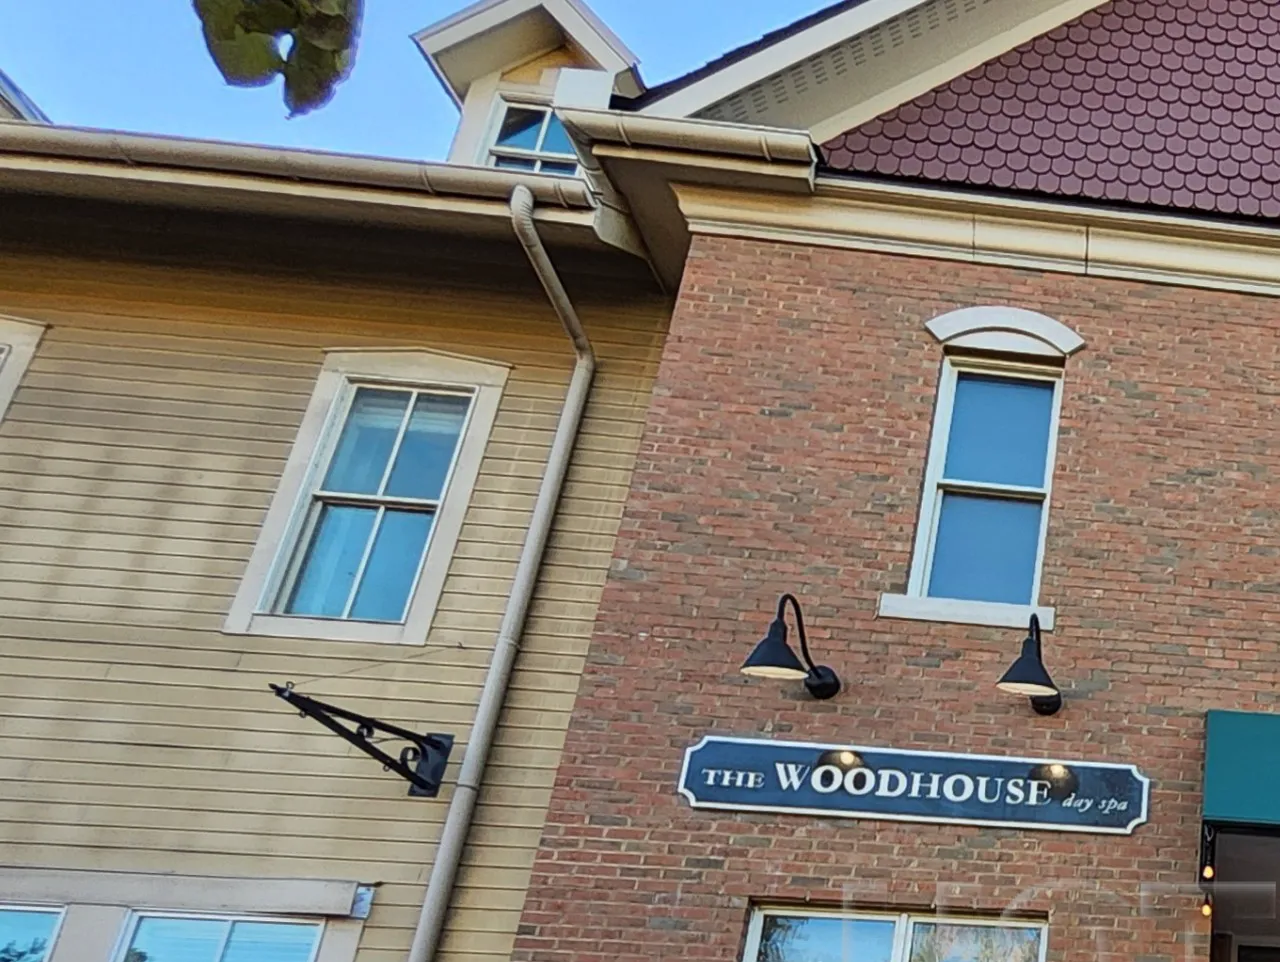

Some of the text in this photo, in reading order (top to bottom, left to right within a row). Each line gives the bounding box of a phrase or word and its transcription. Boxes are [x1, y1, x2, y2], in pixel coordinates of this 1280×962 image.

[701, 762, 1130, 815] THE WOODHOUSE day spa
